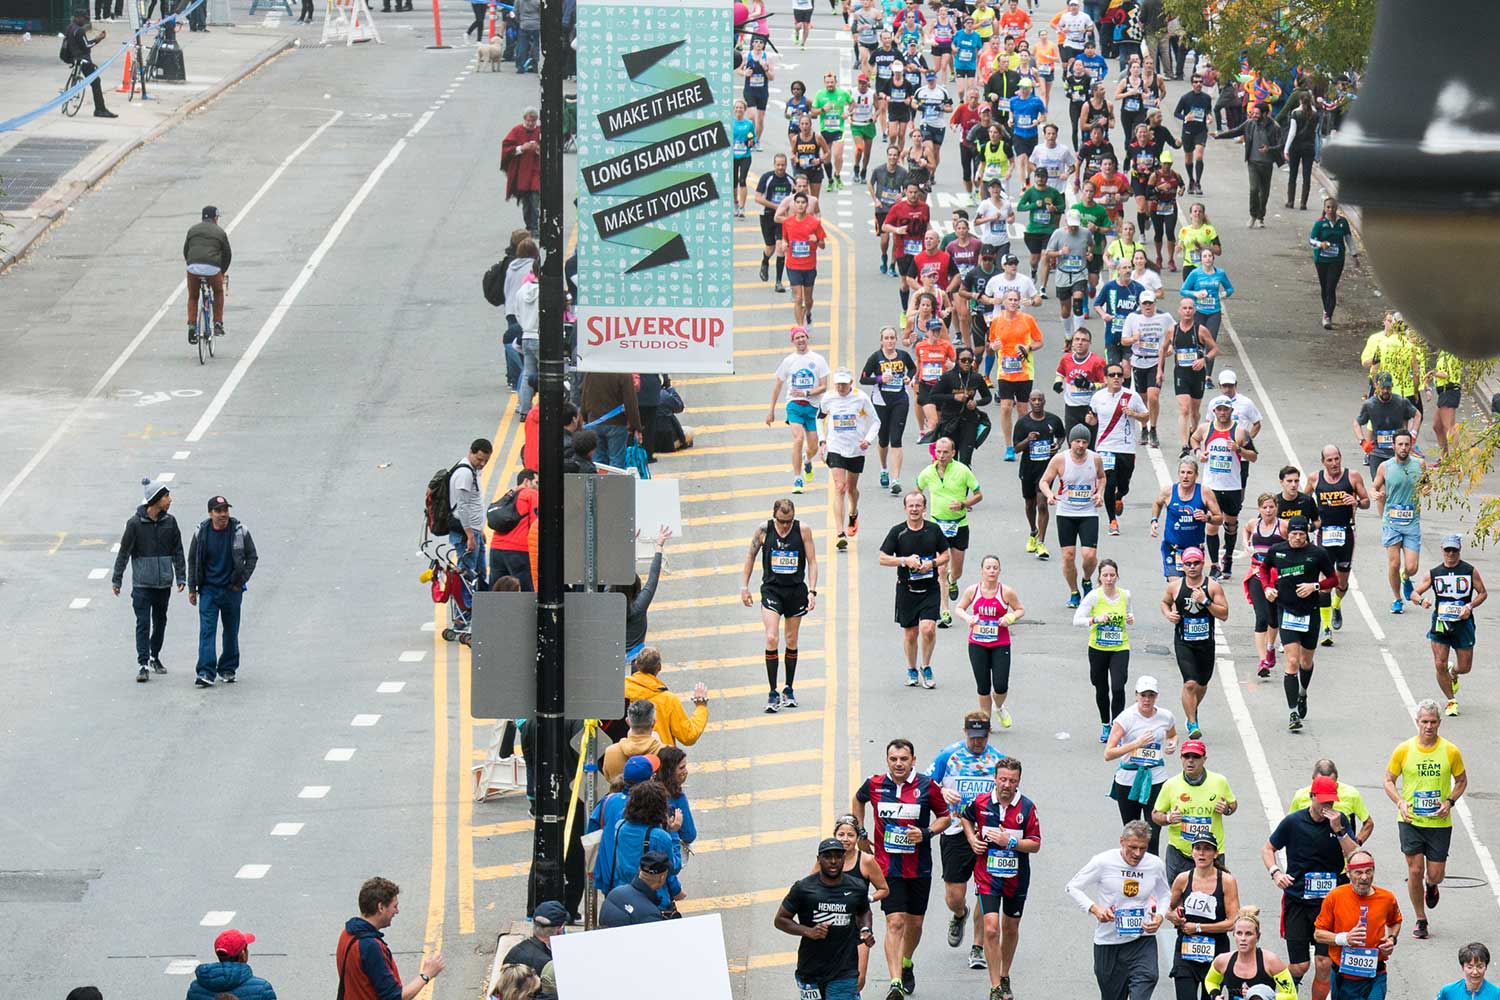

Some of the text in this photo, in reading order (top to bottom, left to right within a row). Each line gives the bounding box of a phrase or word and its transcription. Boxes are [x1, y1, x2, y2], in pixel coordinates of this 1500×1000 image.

[608, 85, 703, 132] MAKE IT HERE
[591, 128, 720, 186] LONG ISLAND CITY
[604, 182, 709, 232] MAKE IT YOURS
[1117, 299, 1137, 309] ANDY
[587, 316, 725, 348] SILVERCUP
[619, 340, 689, 349] STUDIOS
[1319, 492, 1345, 500] NYPD
[1178, 515, 1193, 523] JON
[879, 810, 897, 818] NY
[1120, 870, 1144, 879] TEAM
[818, 902, 847, 912] HENDRIX
[1186, 897, 1211, 913] LISA
[1348, 956, 1374, 968] 39032
